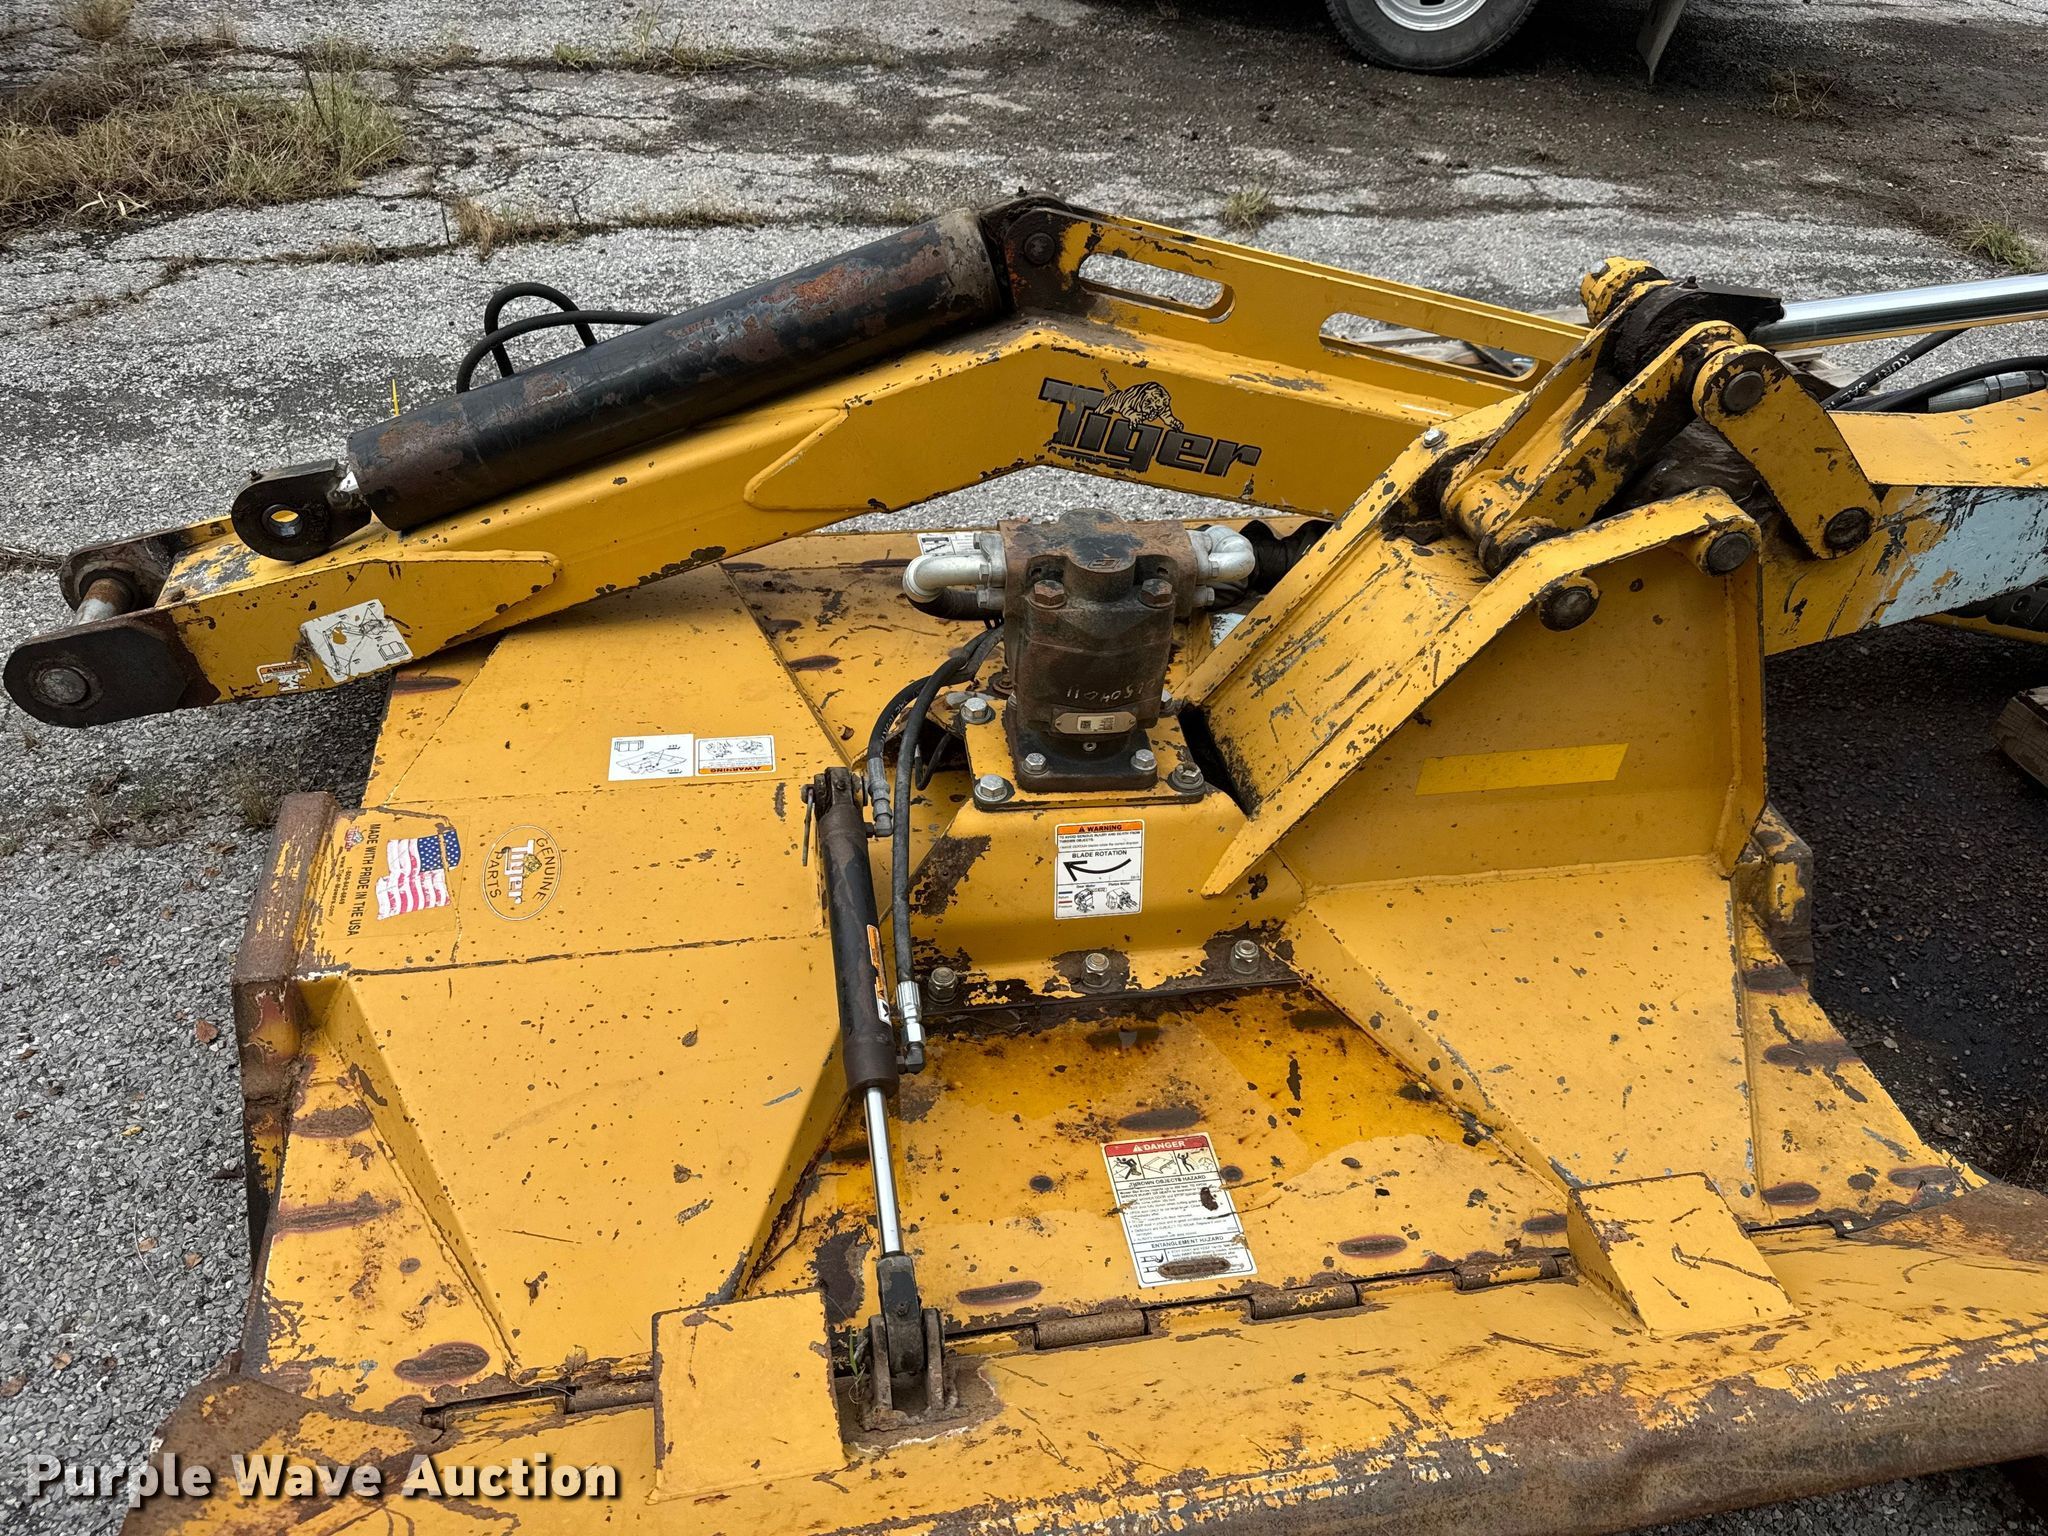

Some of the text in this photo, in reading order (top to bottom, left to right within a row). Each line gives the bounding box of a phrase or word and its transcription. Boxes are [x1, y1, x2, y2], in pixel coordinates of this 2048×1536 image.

[1875, 354, 1911, 380] KURT
[1038, 377, 1262, 477] Tiger
[1087, 824, 1122, 832] WARNING
[1072, 850, 1093, 858] BLADE
[347, 824, 381, 936] MADE WITH PRIDE IN THE USA
[487, 851, 503, 898] PARTS
[502, 839, 535, 904] Tiger
[532, 837, 556, 902] GENUINE
[1143, 1140, 1186, 1151] DANGER
[1155, 1177, 1182, 1185] OBJECTS
[1151, 1239, 1198, 1249] ENTANGLEMENT
[1199, 1235, 1224, 1243] HAZARD
